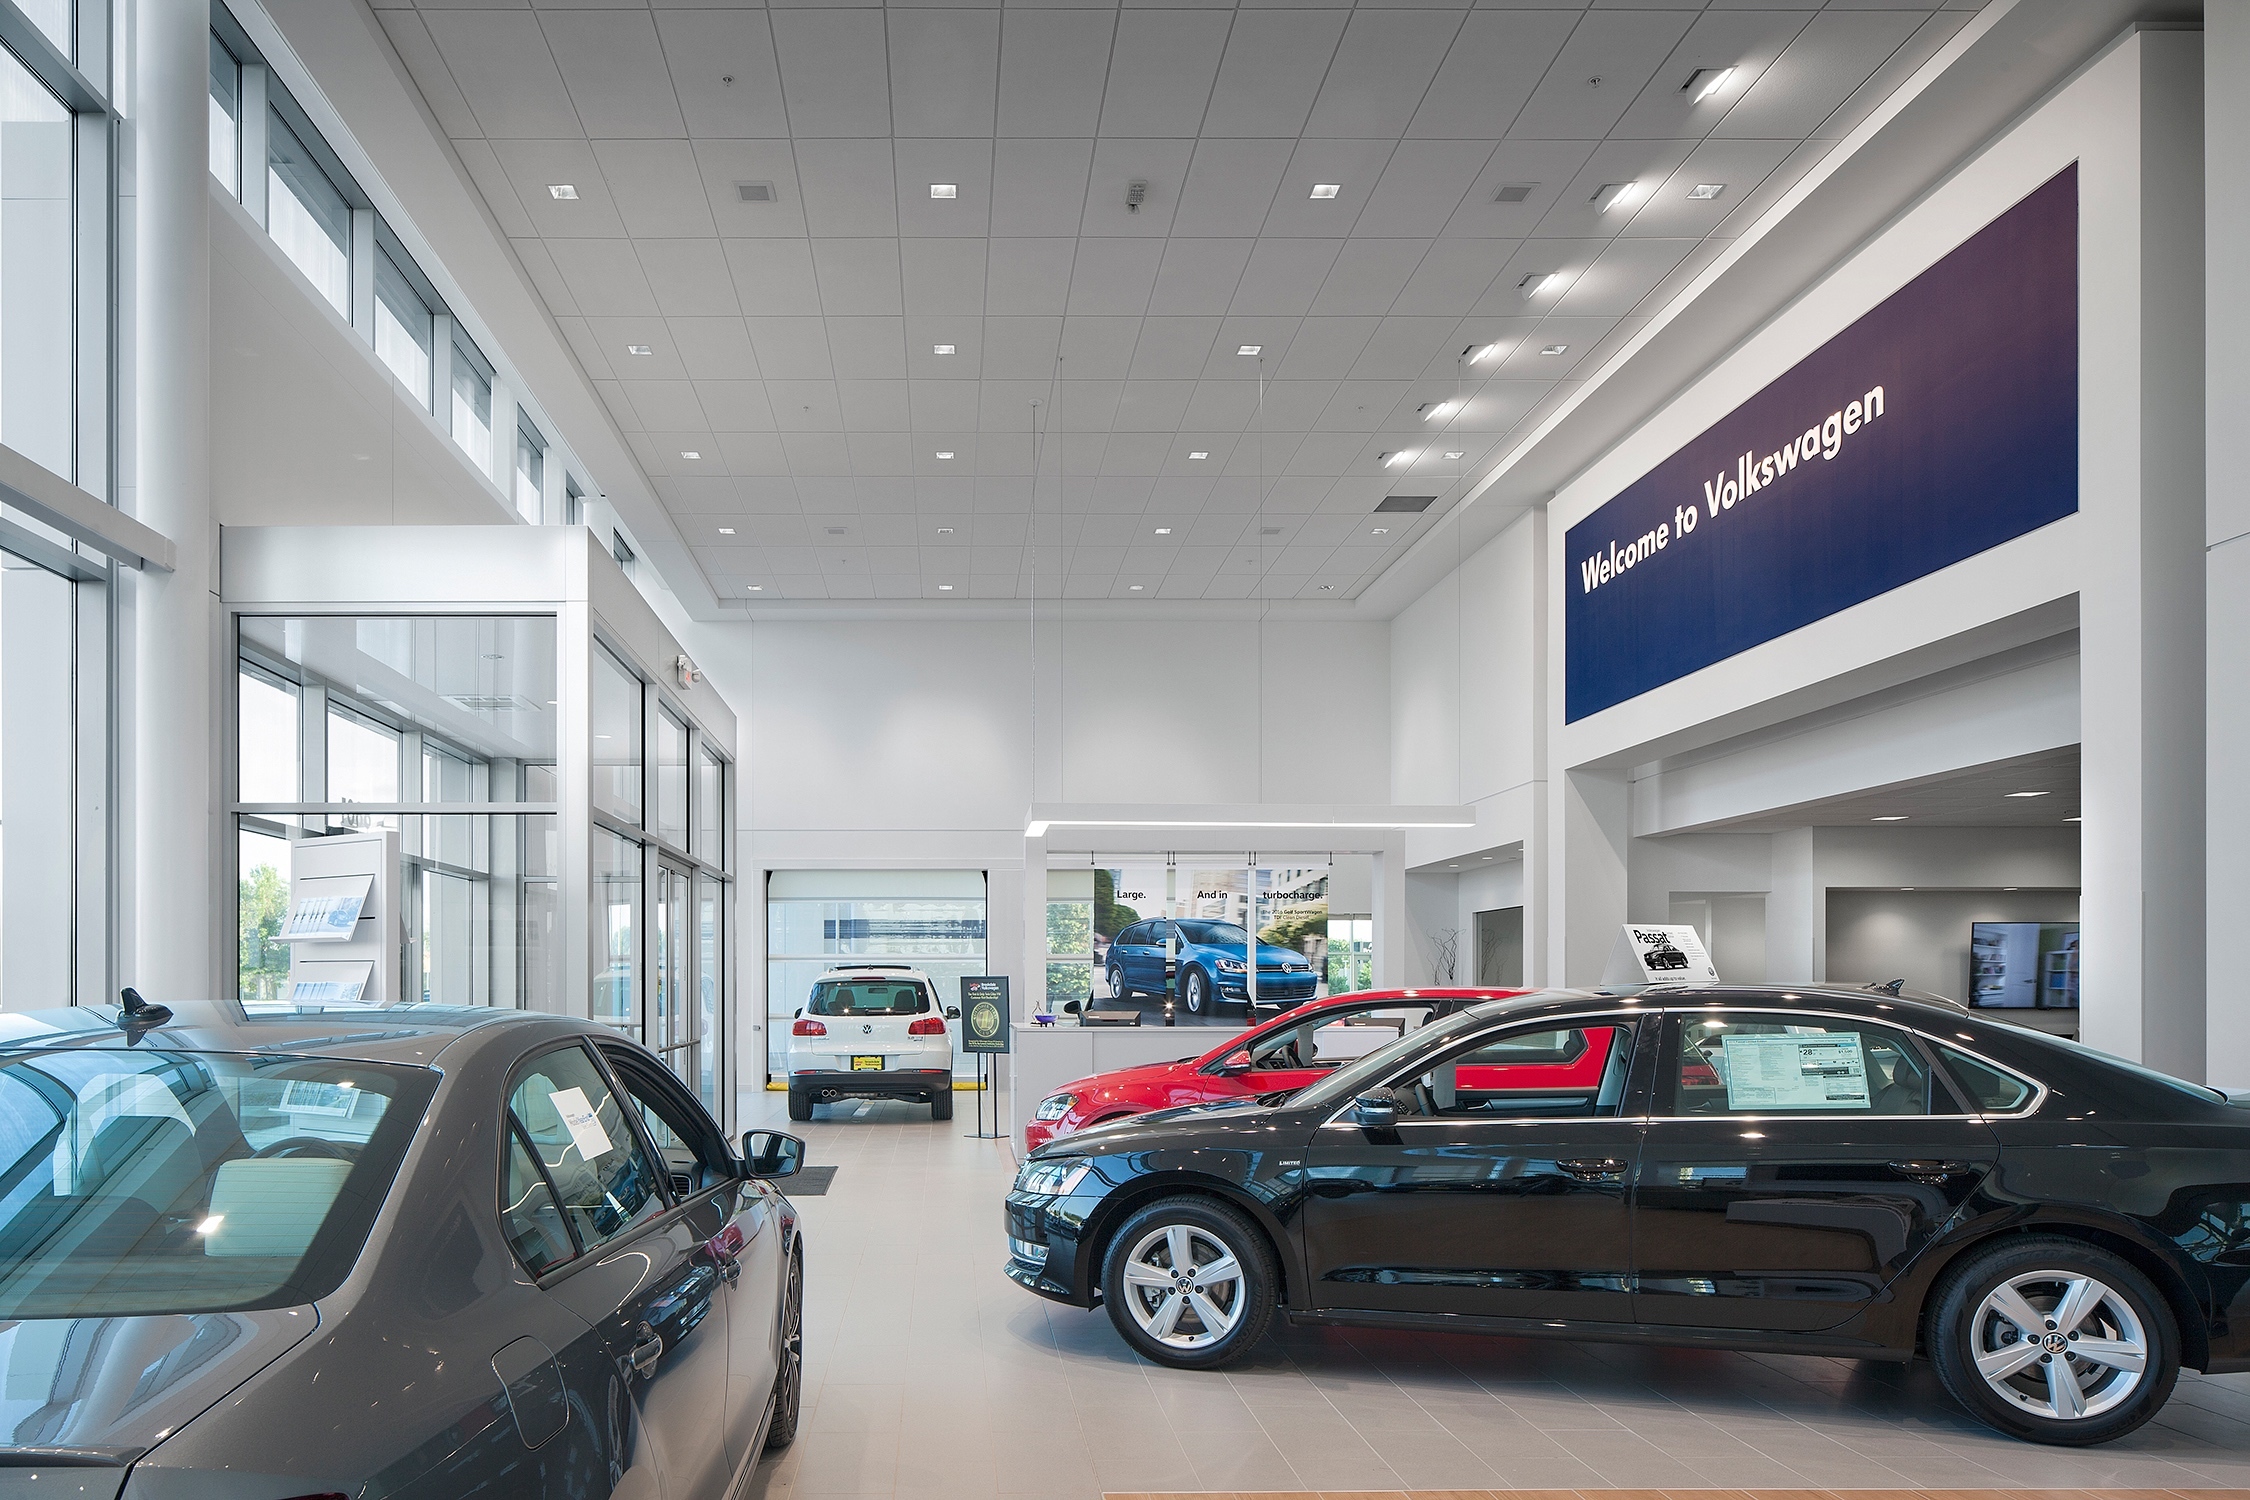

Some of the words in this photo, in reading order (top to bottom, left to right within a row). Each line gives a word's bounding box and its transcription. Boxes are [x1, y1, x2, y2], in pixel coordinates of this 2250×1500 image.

[1581, 523, 1669, 594] Welcome
[1675, 505, 1698, 539] to
[1704, 385, 1885, 519] Volkswagen
[1116, 890, 1146, 901] Large.
[1197, 890, 1217, 900] And
[1219, 890, 1228, 900] in
[1263, 890, 1323, 901] turbocharge.
[1633, 929, 1671, 943] Passat
